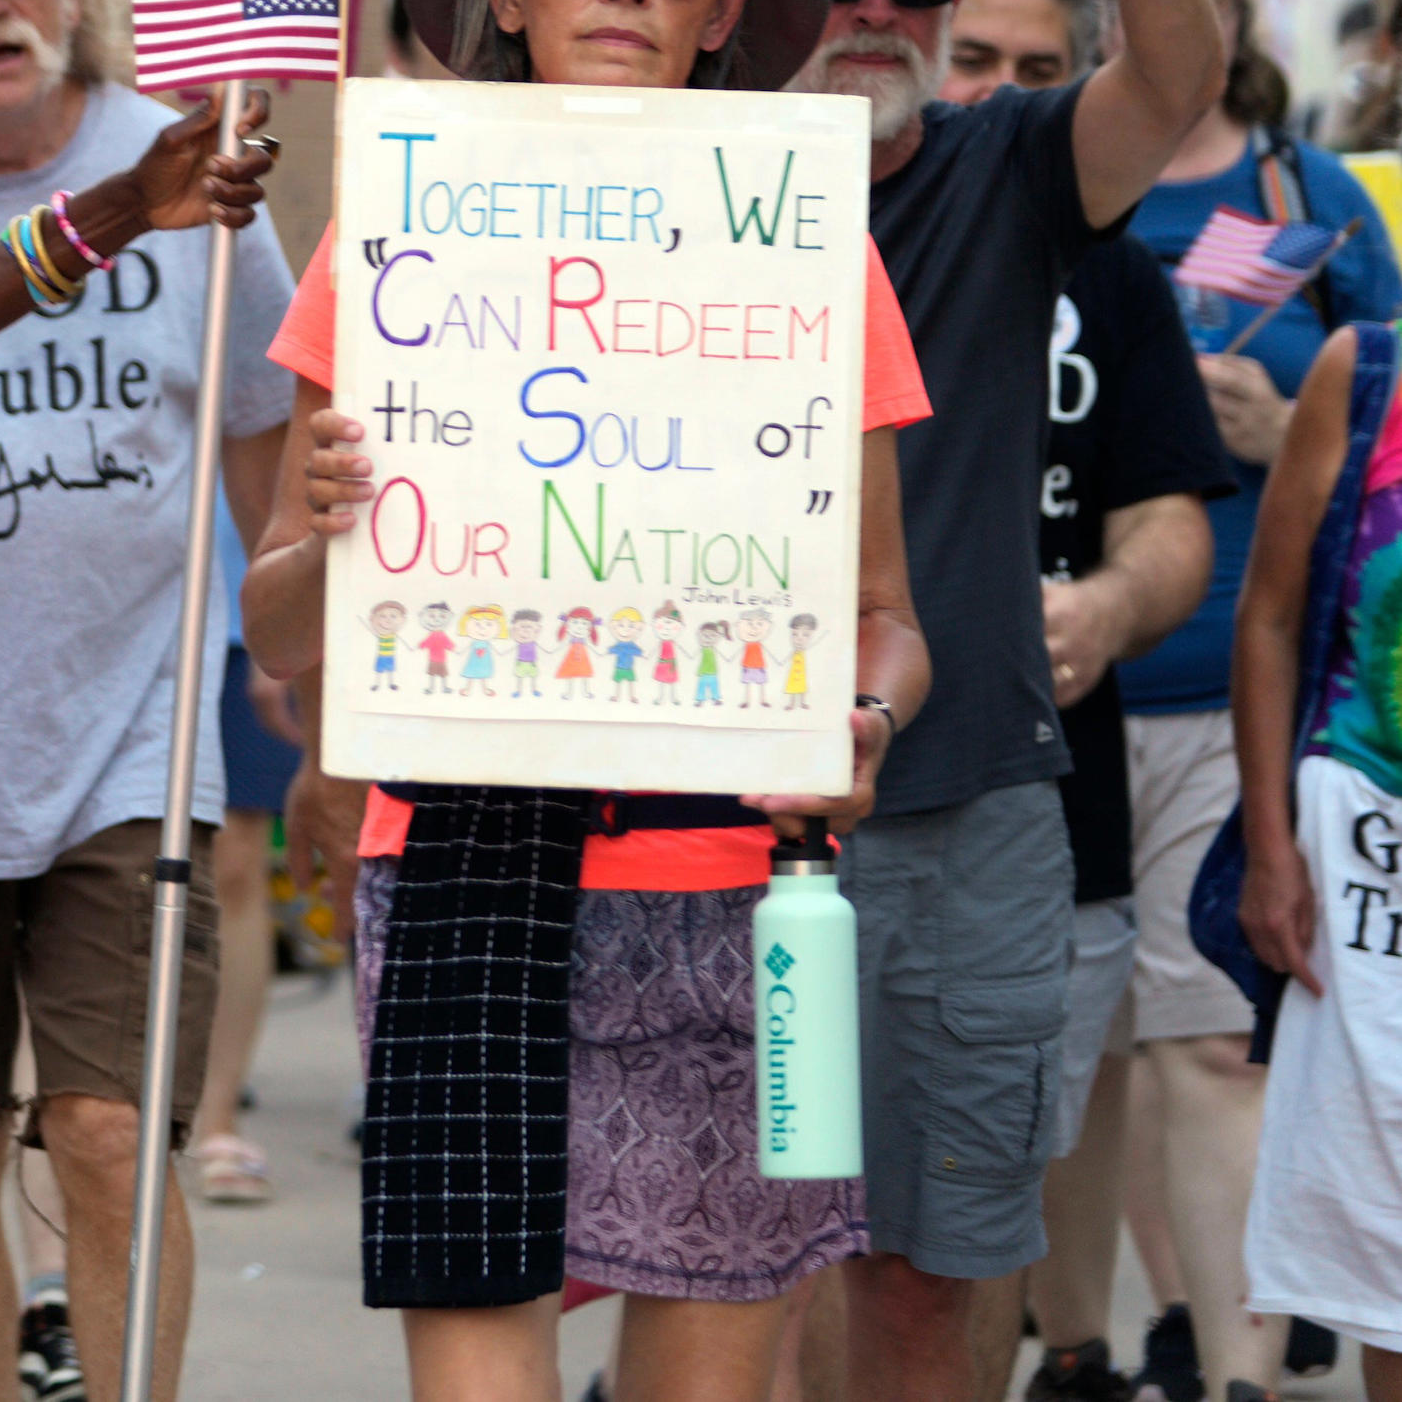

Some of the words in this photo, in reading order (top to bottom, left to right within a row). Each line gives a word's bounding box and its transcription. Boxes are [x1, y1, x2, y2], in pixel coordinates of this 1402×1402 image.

[379, 132, 683, 253] TOGETHER,
[547, 254, 832, 362] REDEEM
[373, 380, 474, 447] the
[518, 366, 716, 471] SOUL
[756, 395, 833, 459] of
[370, 476, 511, 577] OUR
[765, 983, 798, 1155] Columbia
